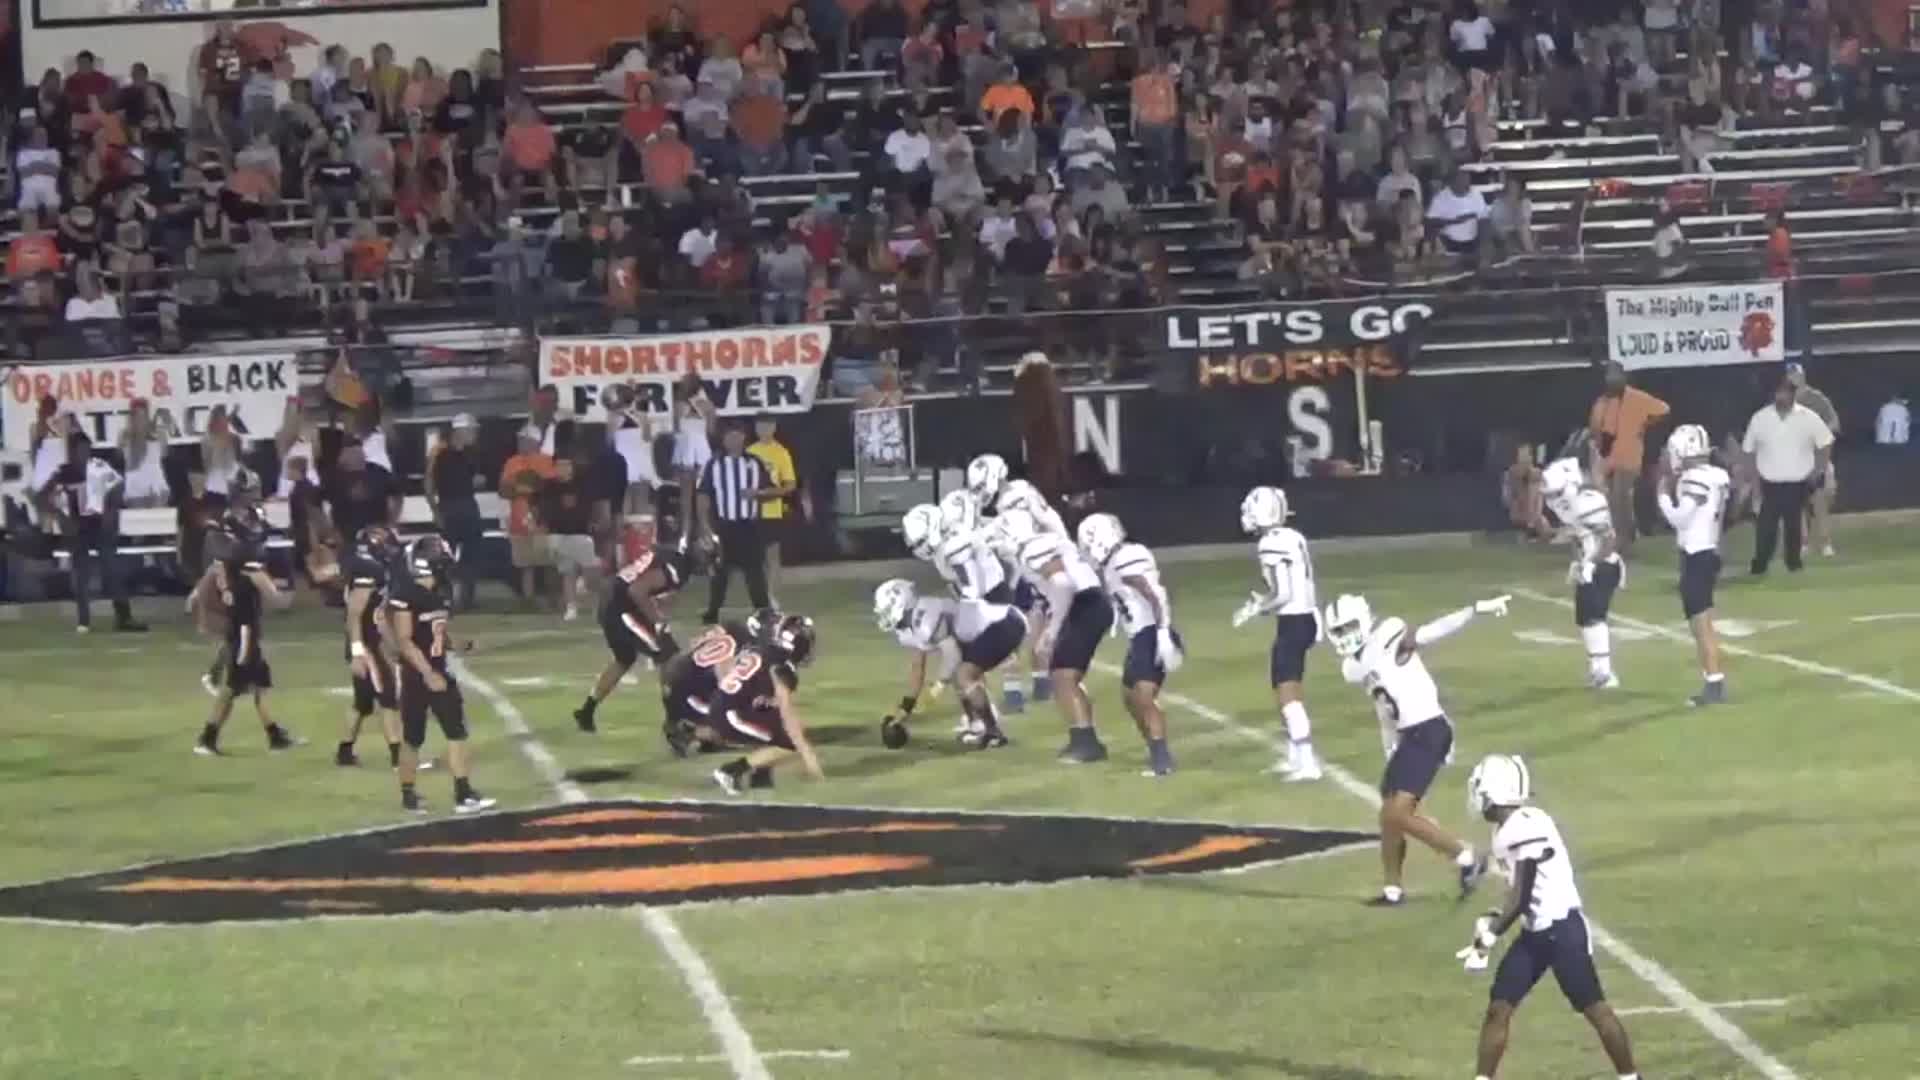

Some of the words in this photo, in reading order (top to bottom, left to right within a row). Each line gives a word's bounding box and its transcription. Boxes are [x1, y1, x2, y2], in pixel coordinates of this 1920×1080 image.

[1616, 298, 1644, 317] The
[1649, 296, 1705, 317] Mighty
[1167, 310, 1323, 348] LET'S
[550, 332, 822, 377] SHORTHORNS
[11, 368, 137, 403] ORANGE
[151, 368, 174, 397] &
[187, 359, 288, 393] BLACK
